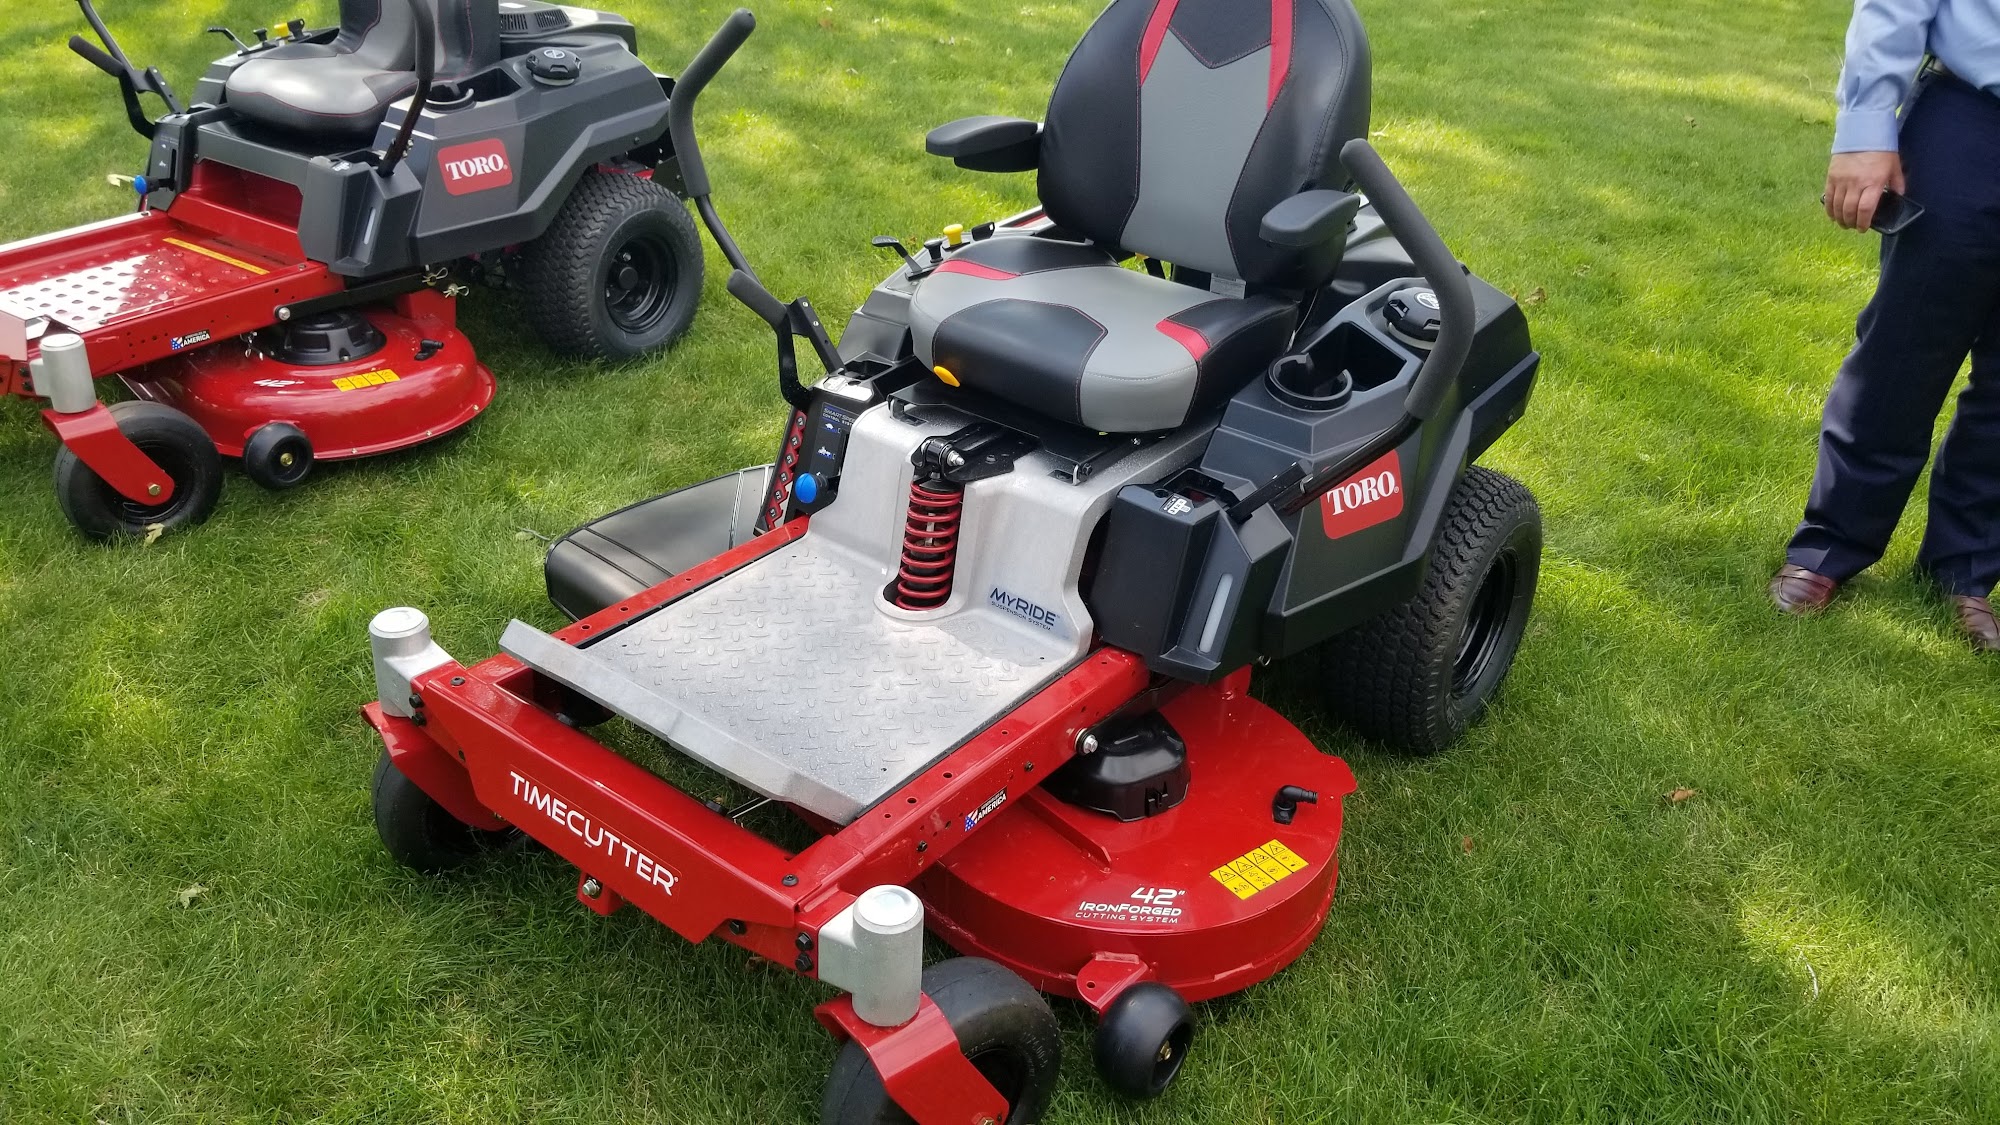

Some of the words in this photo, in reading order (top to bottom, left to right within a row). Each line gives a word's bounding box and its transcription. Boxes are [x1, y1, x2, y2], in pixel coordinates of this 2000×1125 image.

[445, 153, 504, 181] TORO
[184, 333, 210, 346] AMERICA
[1327, 471, 1396, 515] TORO
[990, 587, 1057, 627] MYRIDE
[991, 601, 1027, 620] SUSPENSION
[1028, 617, 1051, 631] SYSTEM
[978, 793, 1007, 821] AMERICA
[510, 771, 676, 897] TIMECUTTER
[1075, 912, 1126, 921] CUTTING
[1130, 915, 1178, 924] SYSTEM
[1079, 901, 1182, 917] IRONFORGED
